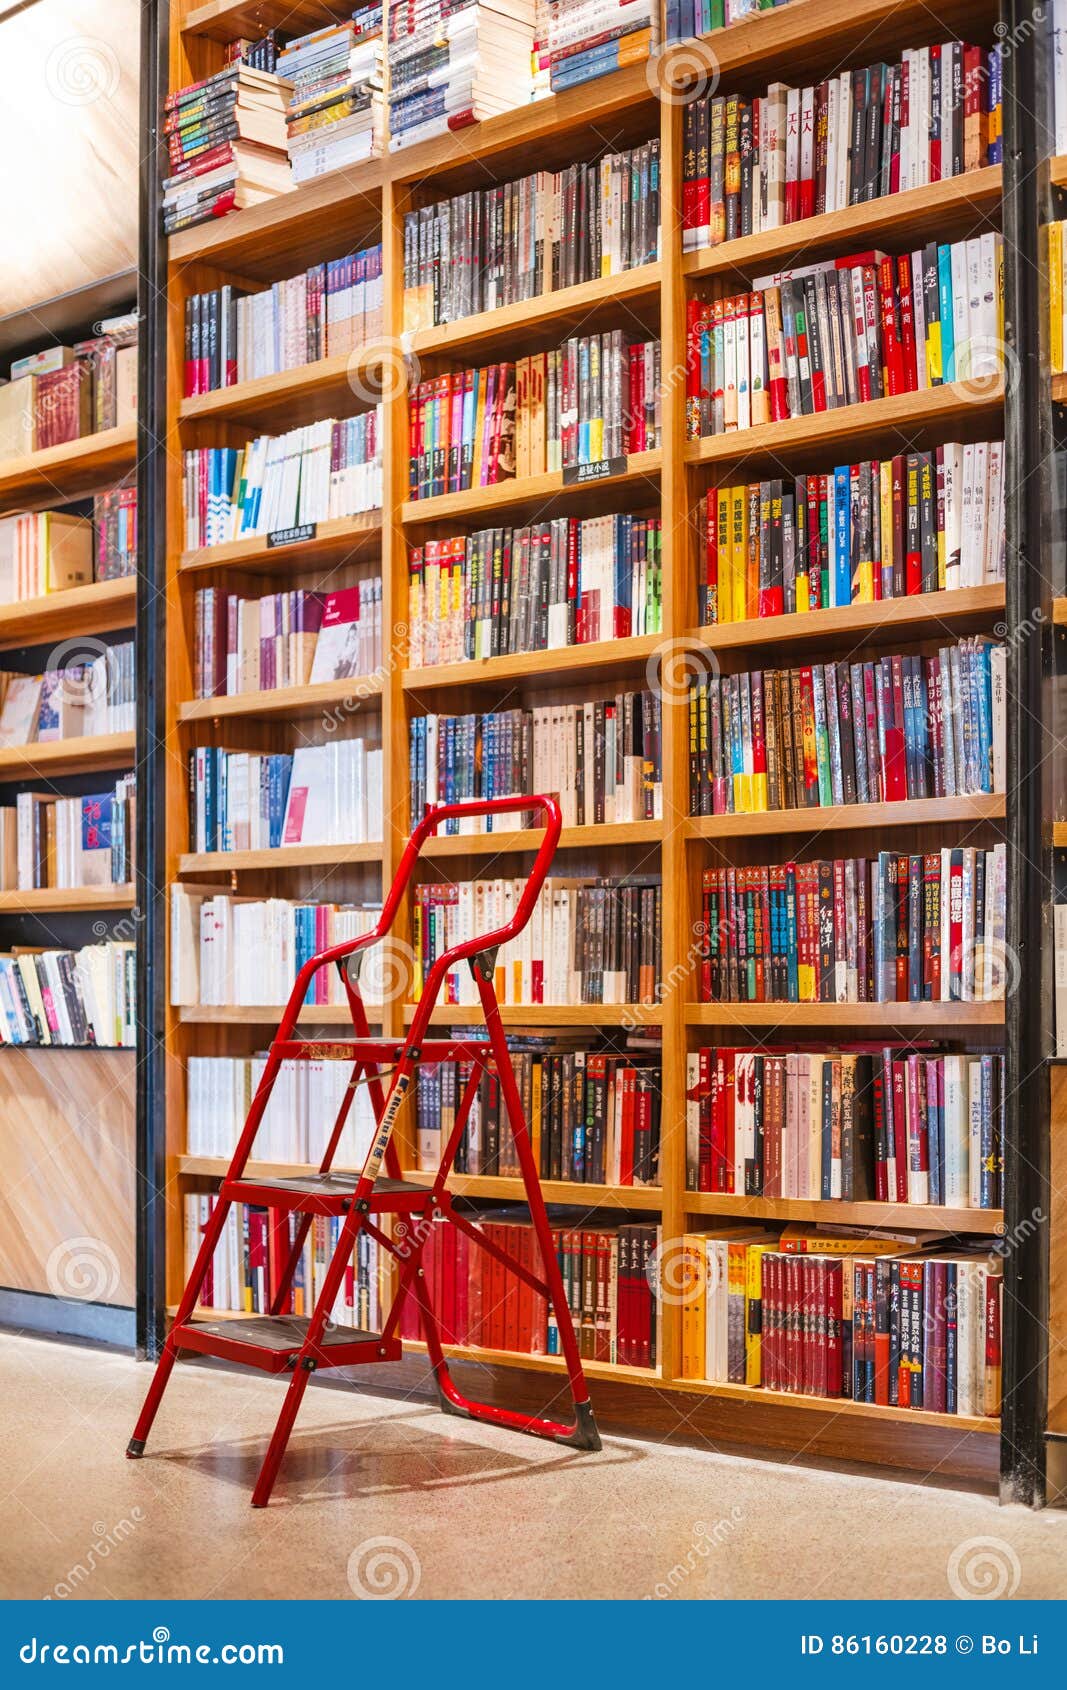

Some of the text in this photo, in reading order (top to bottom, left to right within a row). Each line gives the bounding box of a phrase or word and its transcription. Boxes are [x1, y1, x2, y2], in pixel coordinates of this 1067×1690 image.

[787, 113, 797, 136] 工人
[802, 110, 812, 133] 工人
[884, 297, 894, 325] 情商
[772, 498, 782, 519] 对手
[820, 906, 833, 948] 红海洋
